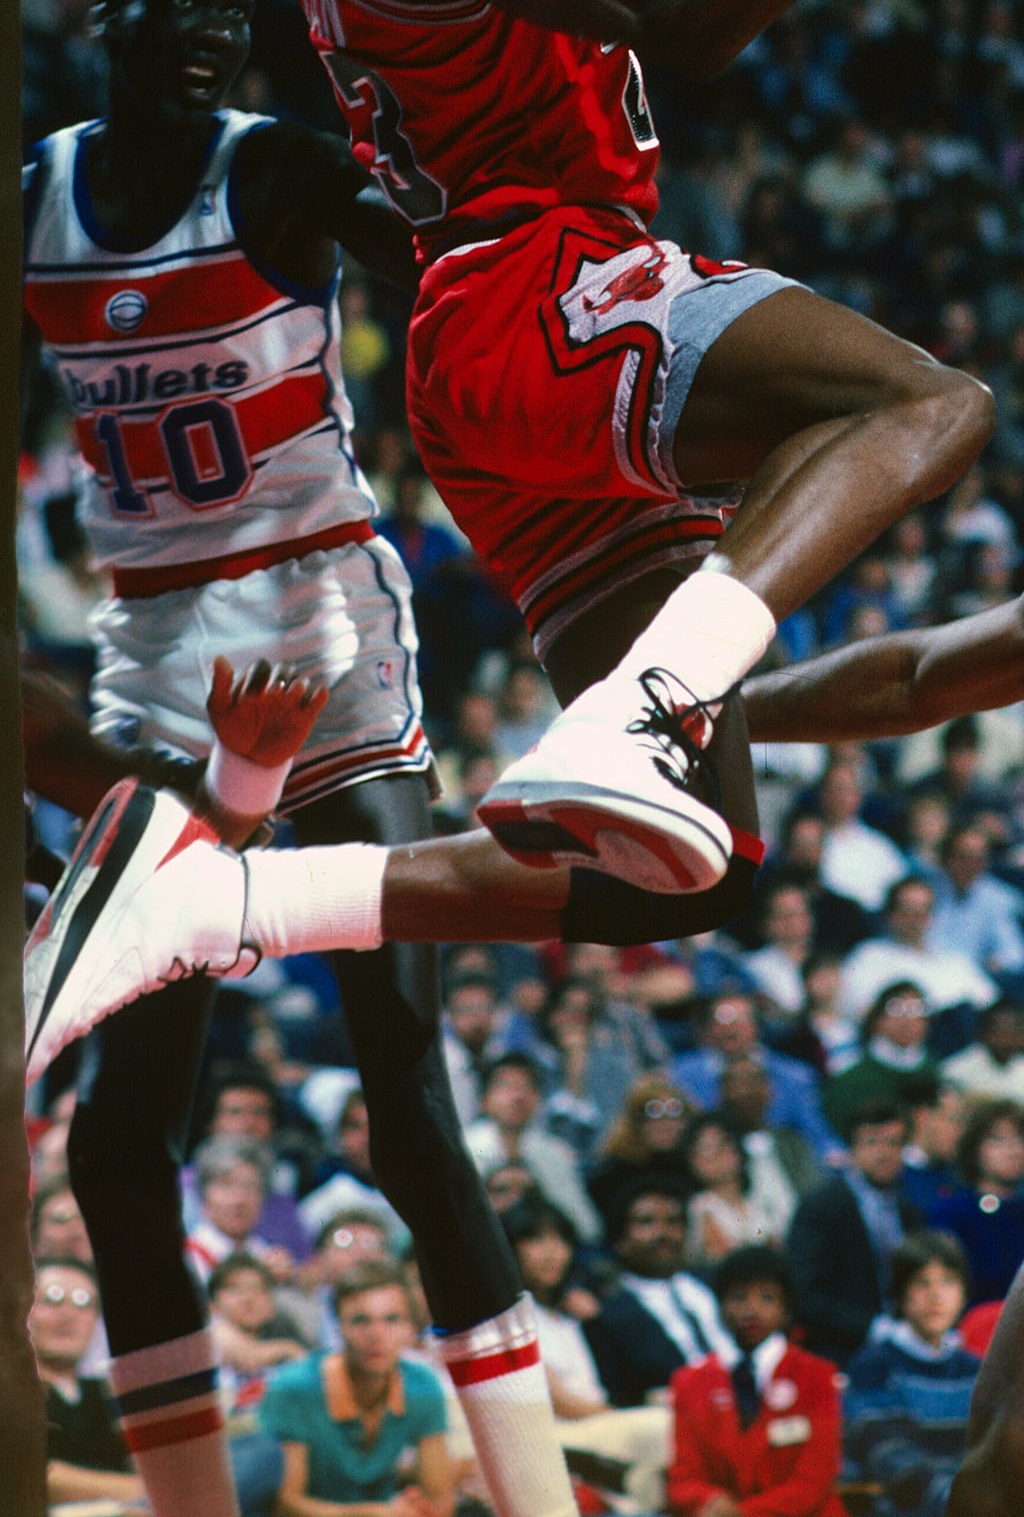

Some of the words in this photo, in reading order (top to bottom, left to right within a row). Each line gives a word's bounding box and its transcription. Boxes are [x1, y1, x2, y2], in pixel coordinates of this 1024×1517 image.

[319, 50, 448, 229] 3
[64, 359, 249, 407] bullets
[93, 393, 257, 520] 10
